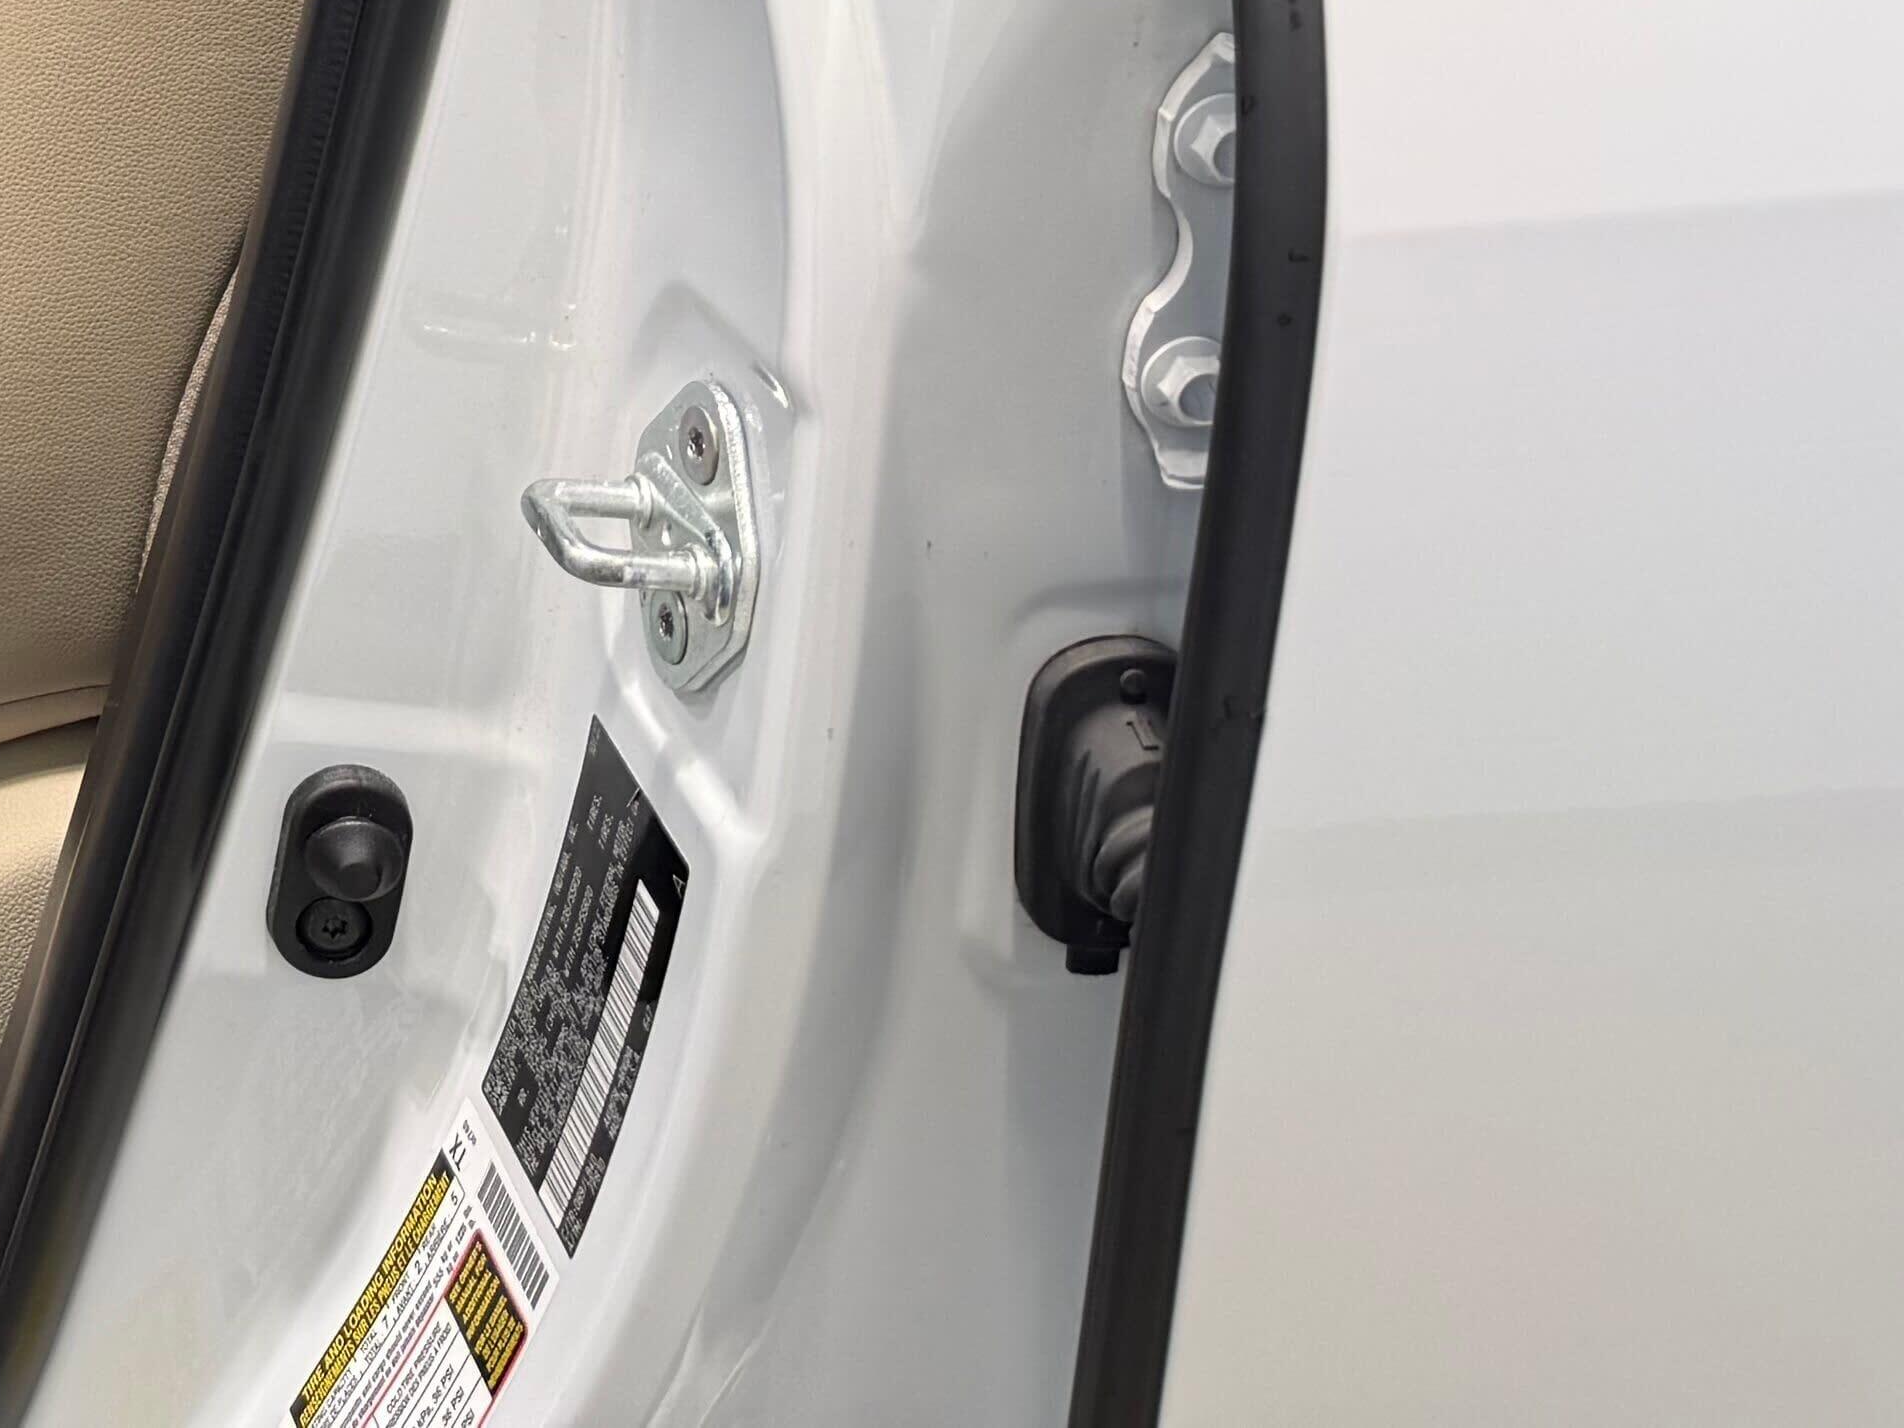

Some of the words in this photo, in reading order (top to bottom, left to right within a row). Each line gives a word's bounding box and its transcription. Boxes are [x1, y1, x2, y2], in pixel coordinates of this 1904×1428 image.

[672, 873, 685, 894] A
[448, 1132, 468, 1171] TX
[449, 1190, 458, 1207] 5
[352, 1316, 368, 1345] SUR
[366, 1296, 380, 1323] LES
[377, 1263, 399, 1305] PNEUS
[396, 1249, 407, 1270] ET
[403, 1235, 415, 1257] LE
[410, 1169, 450, 1243] CHARGEMENT
[413, 1258, 422, 1275] 2
[302, 1364, 325, 1403] TIRE
[322, 1332, 345, 1370] AND
[342, 1269, 384, 1338] LOADING
[381, 1171, 437, 1275] INFORMATION
[381, 1313, 390, 1330] 7
[385, 1384, 403, 1416] COLD
[413, 1320, 442, 1371] PRESSURE
[440, 1363, 455, 1390] PSI
[450, 1385, 464, 1411] PSI
